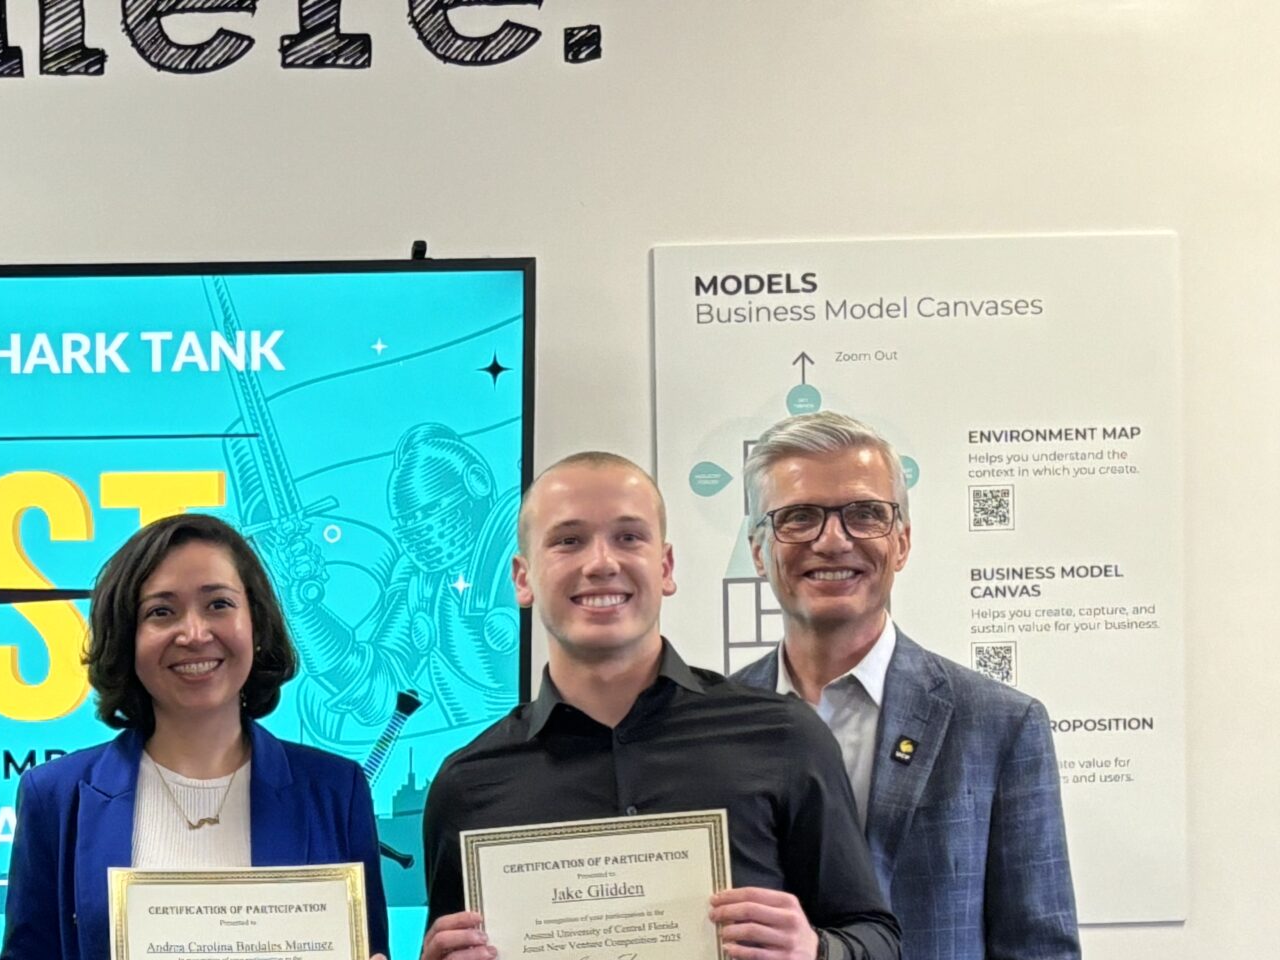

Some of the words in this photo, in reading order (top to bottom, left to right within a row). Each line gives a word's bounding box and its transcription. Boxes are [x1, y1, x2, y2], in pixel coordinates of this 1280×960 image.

[694, 273, 818, 296] MODELS
[695, 301, 816, 324] Business
[825, 297, 907, 320] Model
[917, 296, 1043, 318] Canvases
[141, 330, 285, 372] TANK
[835, 351, 871, 363] Zoom
[875, 350, 898, 362] Out
[968, 428, 1097, 443] ENVIRONMENT
[1102, 427, 1141, 440] MAP
[968, 452, 1003, 465] Helps
[1006, 453, 1029, 464] you
[1032, 450, 1104, 462] understand
[1107, 450, 1128, 460] the
[968, 468, 1015, 478] context
[1018, 467, 1029, 476] in
[1032, 465, 1070, 476] which
[1073, 466, 1095, 478] you
[1098, 464, 1139, 475] create.
[970, 567, 1055, 581] BUSINESS
[1061, 565, 1124, 578] MODEL
[970, 585, 1041, 599] CANVAS
[971, 608, 1006, 620] Helps
[1009, 609, 1031, 620] you
[1035, 607, 1075, 617] create,
[1078, 607, 1129, 617] capture,
[1132, 604, 1156, 615] and
[971, 623, 1015, 634] sustain
[1018, 621, 1051, 633] value
[1054, 620, 1070, 632] for
[1074, 622, 1101, 633] your
[1104, 619, 1160, 630] business.
[1079, 758, 1111, 768] value
[1115, 757, 1131, 768] for
[1072, 773, 1095, 783] and
[1100, 774, 1134, 782] users.
[503, 858, 585, 874] CERTIFICATION
[587, 857, 601, 867] OF
[604, 850, 689, 865] PARTICIPATION
[552, 887, 583, 901] Jake
[587, 882, 645, 898] Glidden
[148, 906, 227, 915] CERTIFICATION
[230, 905, 243, 914] OF
[246, 903, 327, 914] PARTICIPATION
[603, 925, 612, 934] of
[648, 920, 679, 931] Florida
[147, 942, 185, 953] Andrea
[188, 942, 234, 953] Carolina
[285, 941, 333, 951] Martinez
[547, 942, 566, 951] New
